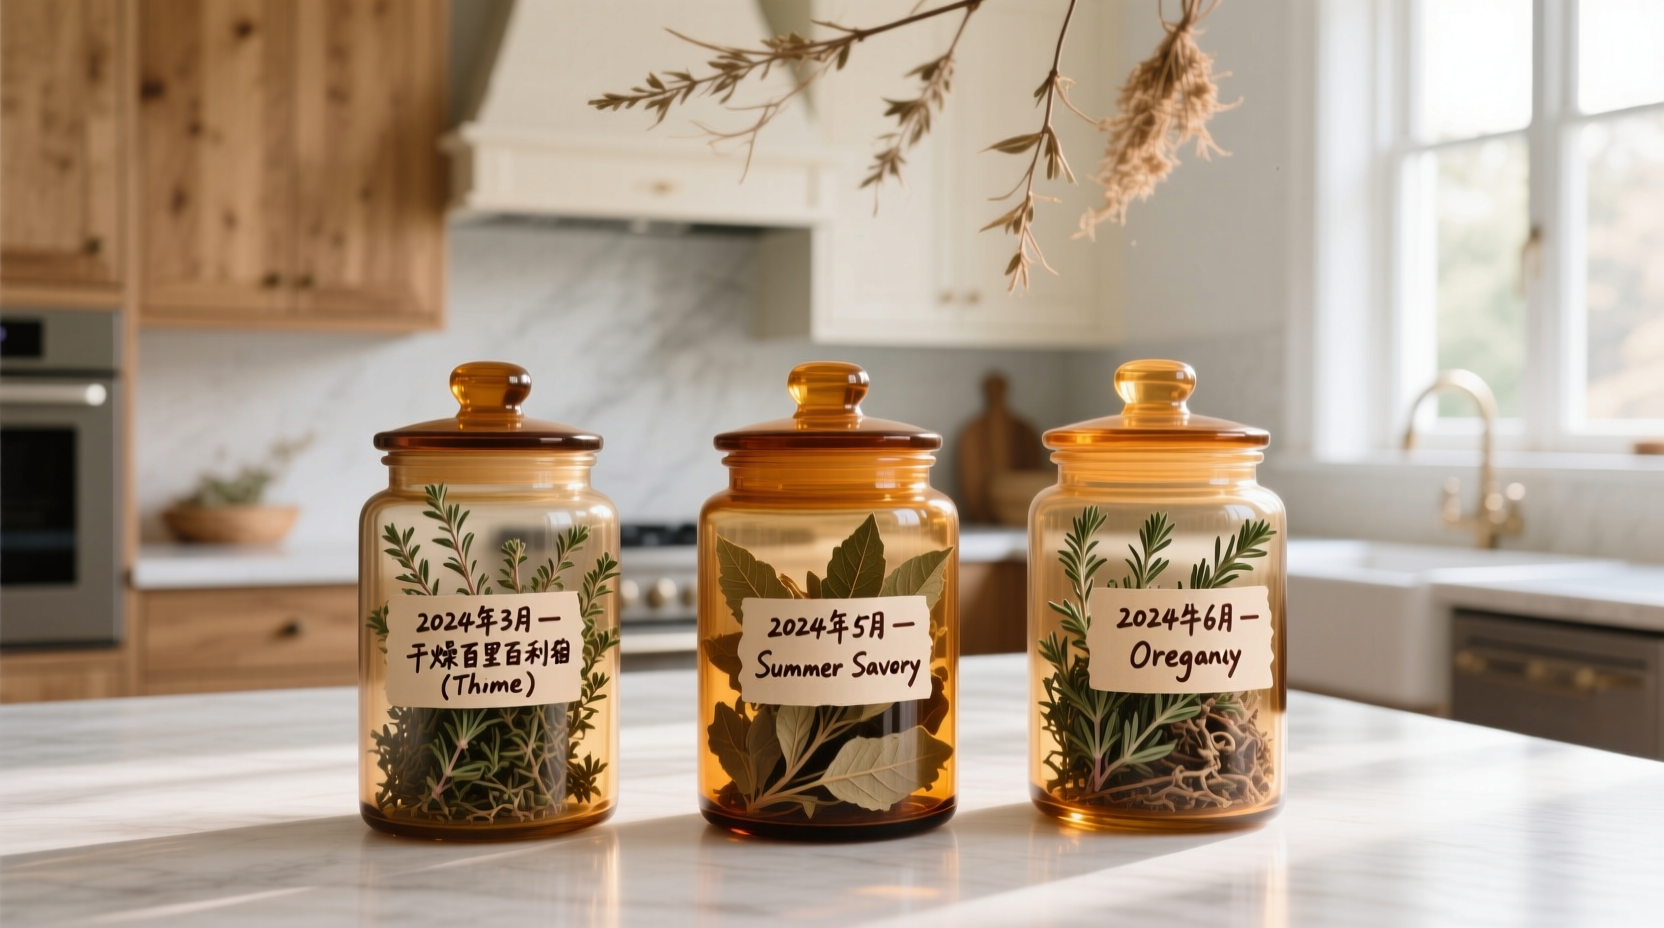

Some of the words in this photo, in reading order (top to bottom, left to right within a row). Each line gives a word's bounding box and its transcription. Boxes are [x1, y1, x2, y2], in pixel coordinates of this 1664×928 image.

[415, 604, 532, 637] 2024年3月
[766, 608, 886, 645] 2024年5月
[440, 670, 537, 701] (Thime)
[754, 648, 845, 680] Summer
[851, 650, 922, 688] Savory
